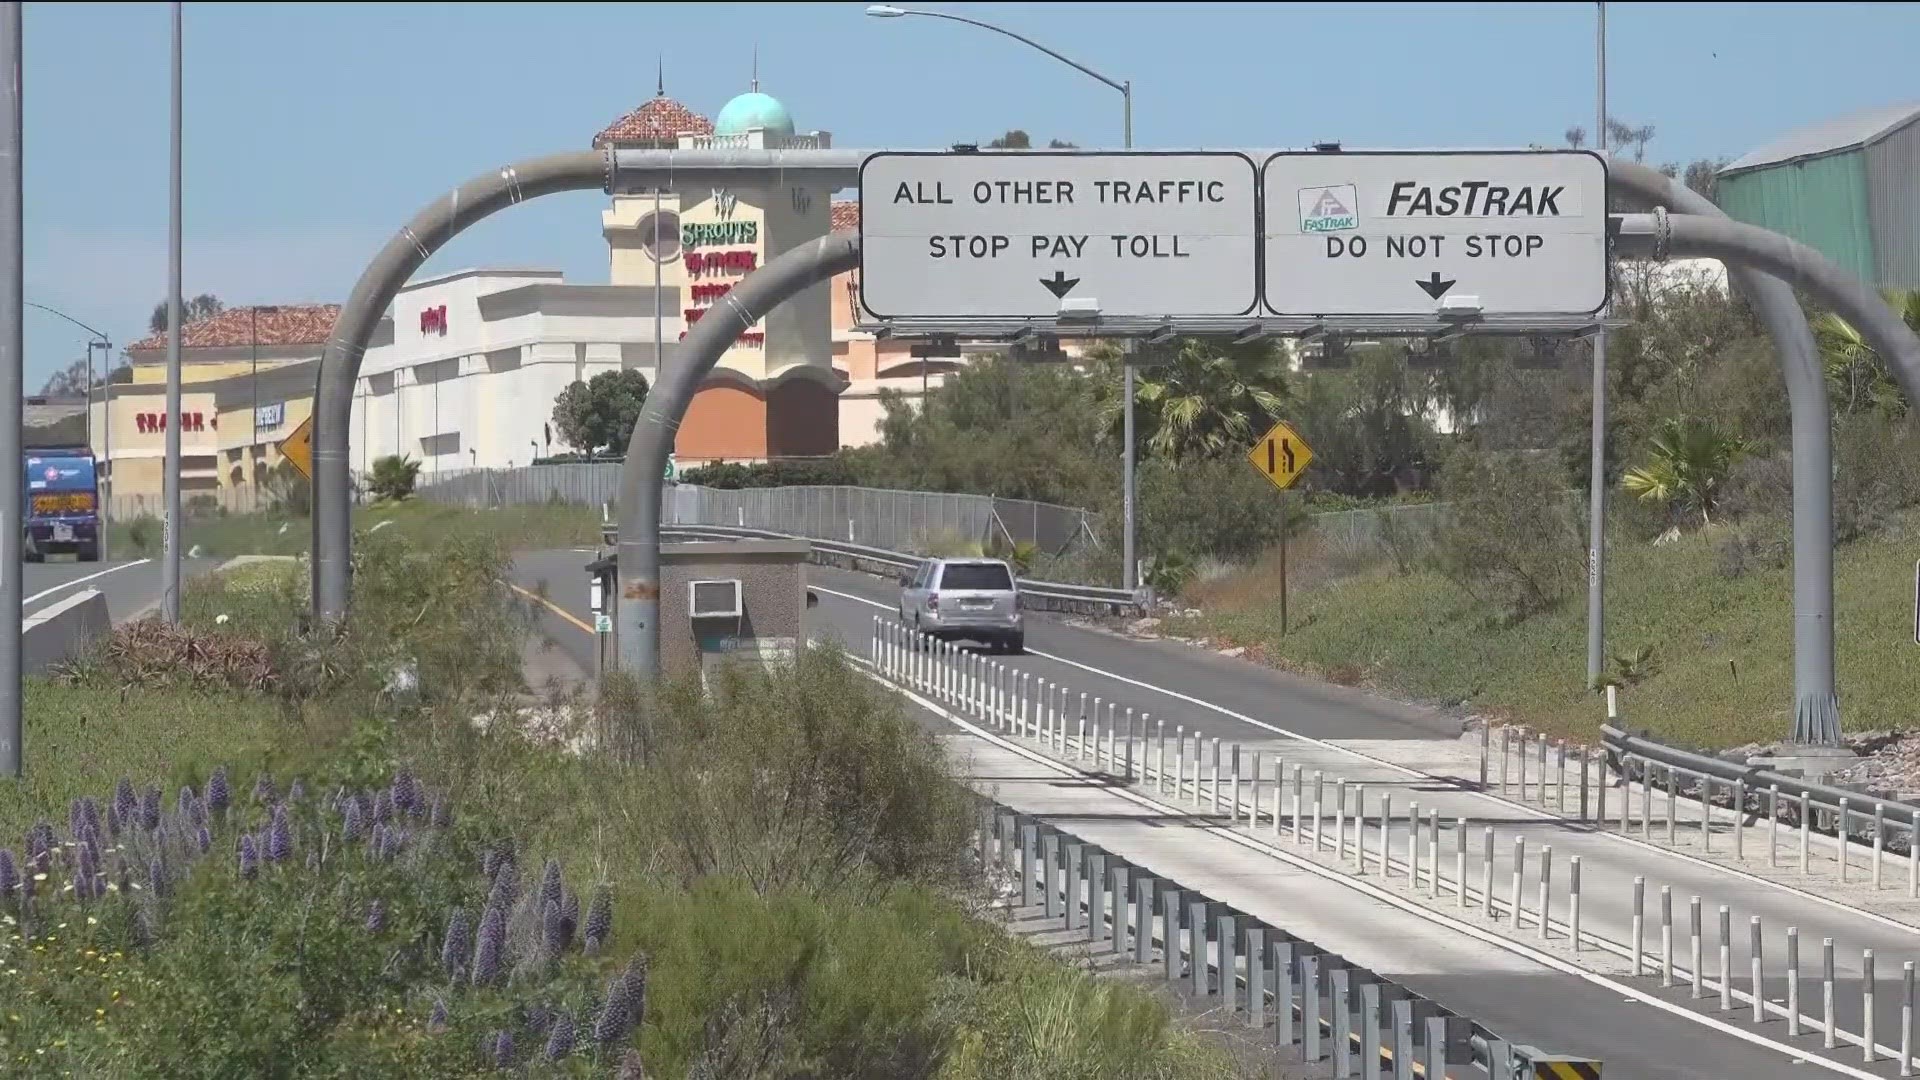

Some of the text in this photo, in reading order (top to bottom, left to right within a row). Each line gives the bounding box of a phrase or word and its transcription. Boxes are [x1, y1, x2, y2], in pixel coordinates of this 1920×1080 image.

[893, 181, 1225, 204] ALL OTHER TRAFFIC
[681, 221, 758, 245] SPROUTS
[929, 235, 1190, 258] STOP PAY TOLL
[1327, 234, 1544, 258] DO NOT STOP
